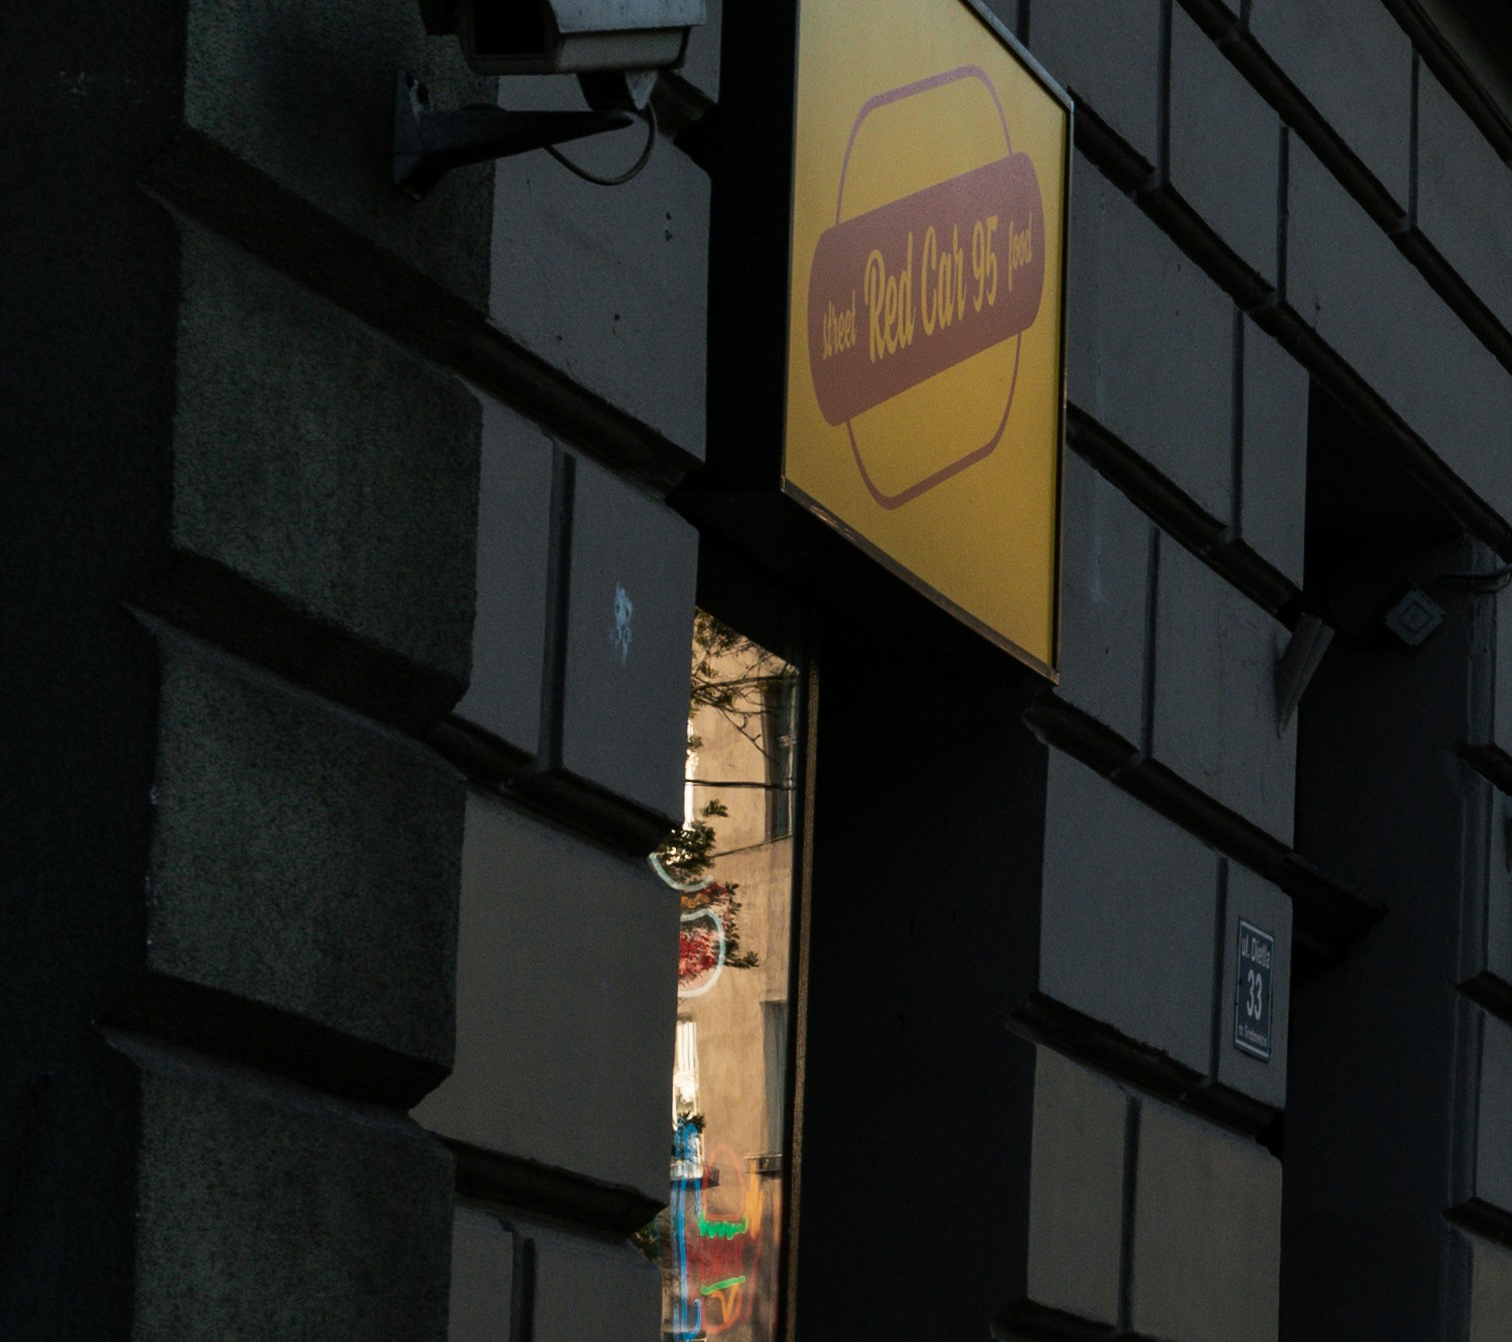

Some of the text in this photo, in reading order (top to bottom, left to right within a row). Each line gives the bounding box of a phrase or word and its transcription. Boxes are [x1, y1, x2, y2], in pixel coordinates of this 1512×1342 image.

[822, 212, 1032, 363] street Red Car 95 food
[1246, 969, 1262, 1020] 33
